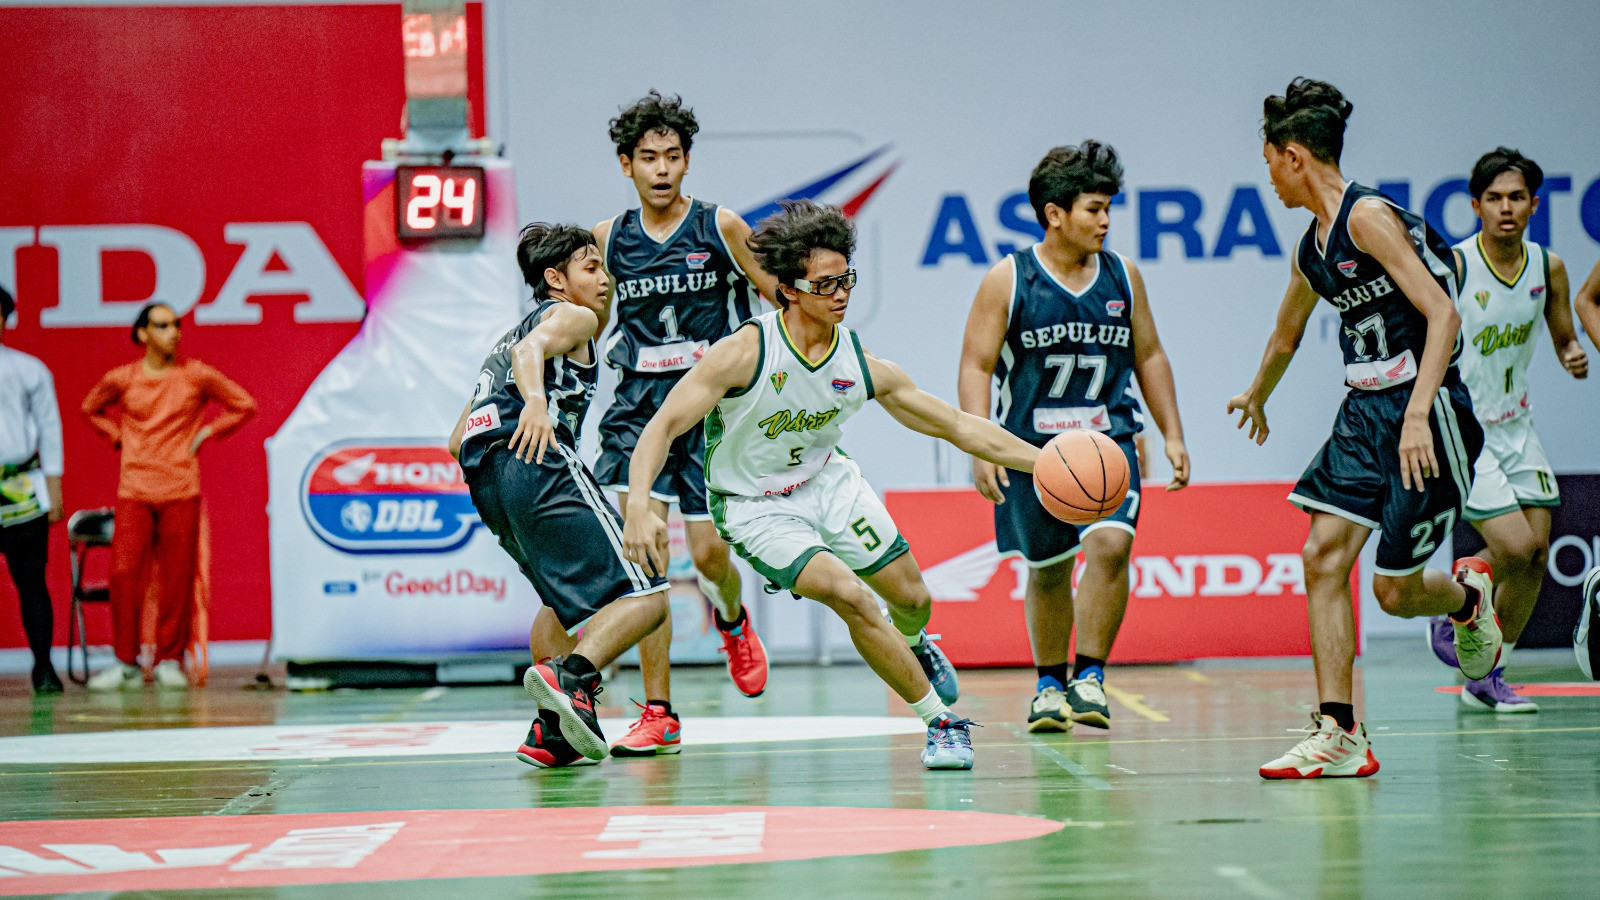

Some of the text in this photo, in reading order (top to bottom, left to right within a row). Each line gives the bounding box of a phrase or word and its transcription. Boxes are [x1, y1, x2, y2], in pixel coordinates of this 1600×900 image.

[406, 174, 476, 230] 24
[922, 185, 1283, 266] ASRA
[618, 271, 718, 302] SEPULUH
[659, 305, 686, 343] 1
[1021, 321, 1131, 349] SEPULUH
[1344, 312, 1390, 361] 27
[641, 360, 657, 368] One
[1044, 354, 1107, 401] 77
[467, 413, 492, 431] Day
[374, 462, 464, 484] HON
[372, 500, 443, 532] DBL
[849, 515, 881, 552] 5
[1411, 507, 1456, 558] 27
[384, 571, 451, 597] Good
[456, 570, 507, 601] Day
[1010, 553, 1308, 600] NDA
